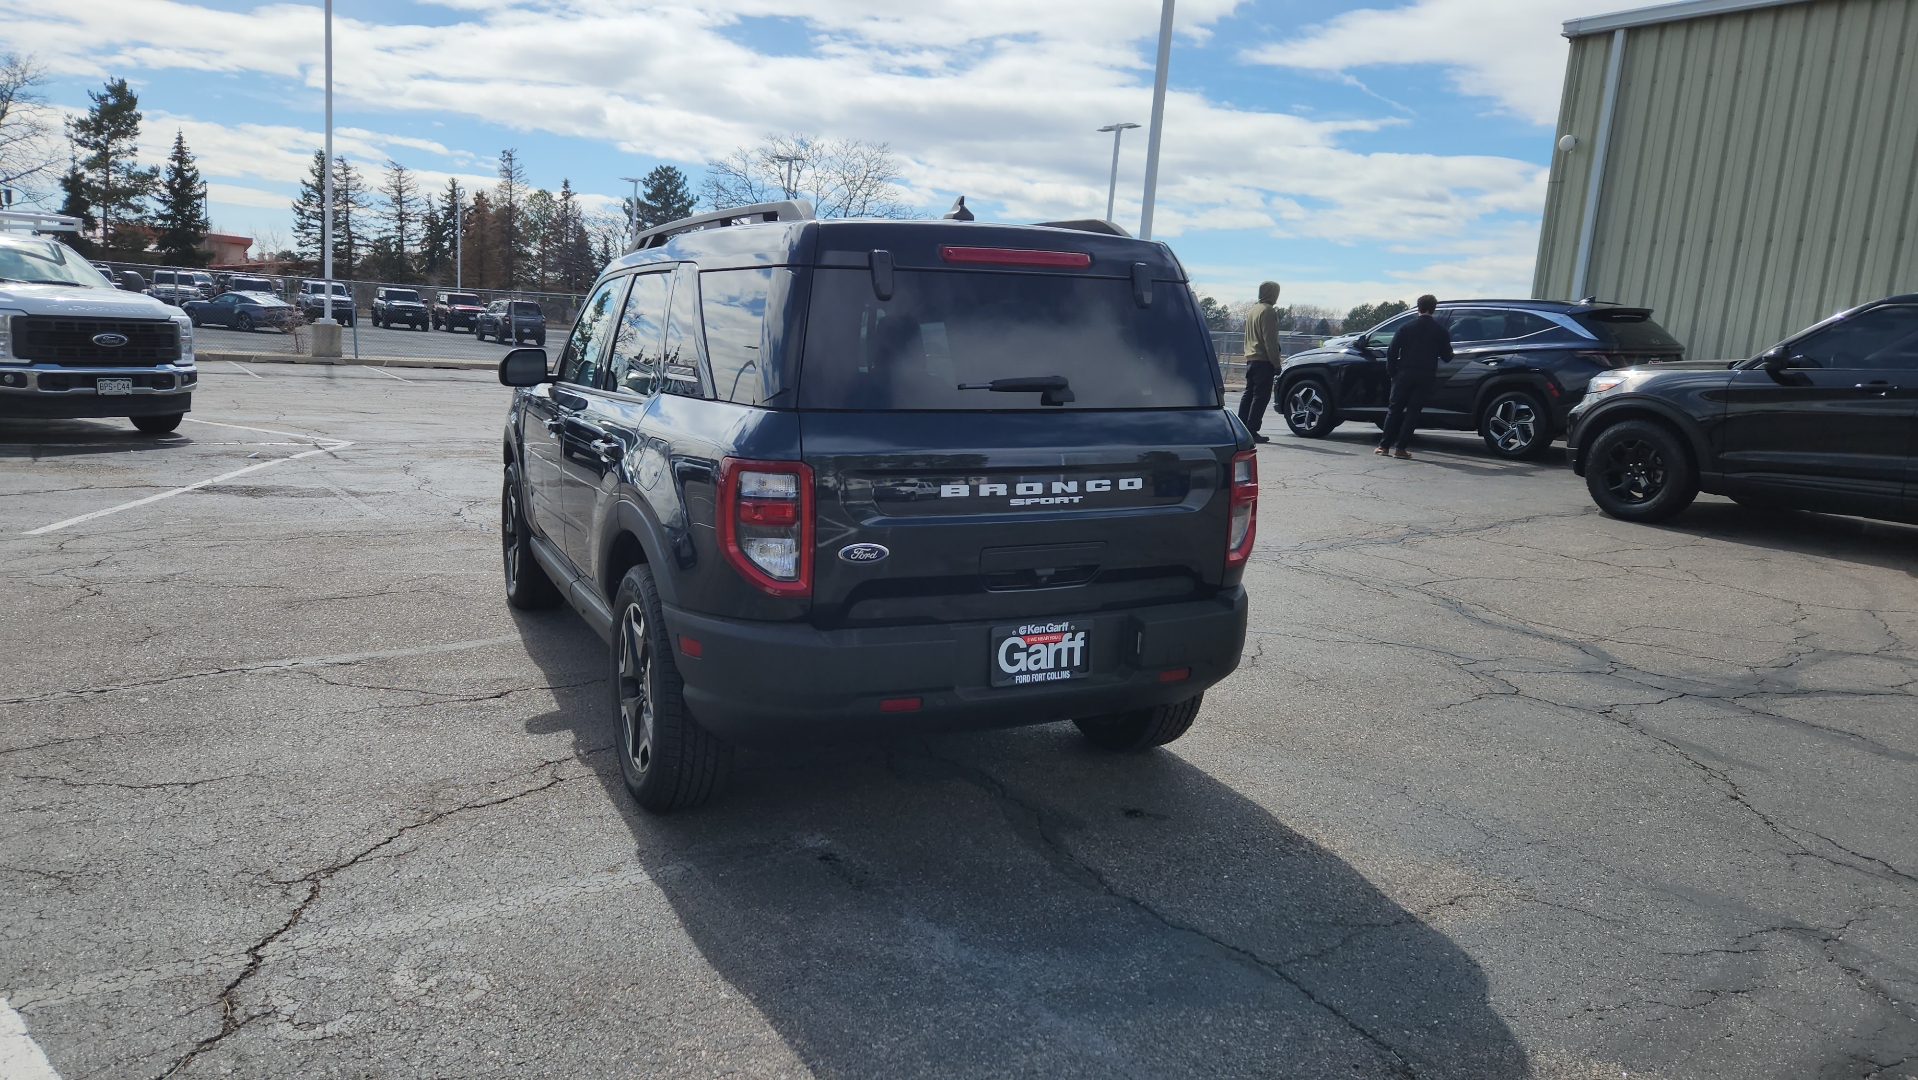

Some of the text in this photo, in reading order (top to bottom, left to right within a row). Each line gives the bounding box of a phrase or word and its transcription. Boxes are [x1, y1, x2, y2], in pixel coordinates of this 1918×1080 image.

[101, 336, 120, 344] Ford
[940, 477, 1143, 498] BRONCO
[1009, 496, 1083, 506] SPORT
[850, 547, 879, 560] Ford
[1027, 624, 1046, 634] Ken
[1046, 621, 1069, 633] Garff
[998, 632, 1085, 674] Garff
[1015, 670, 1071, 684] FORD FORT COLLINS
